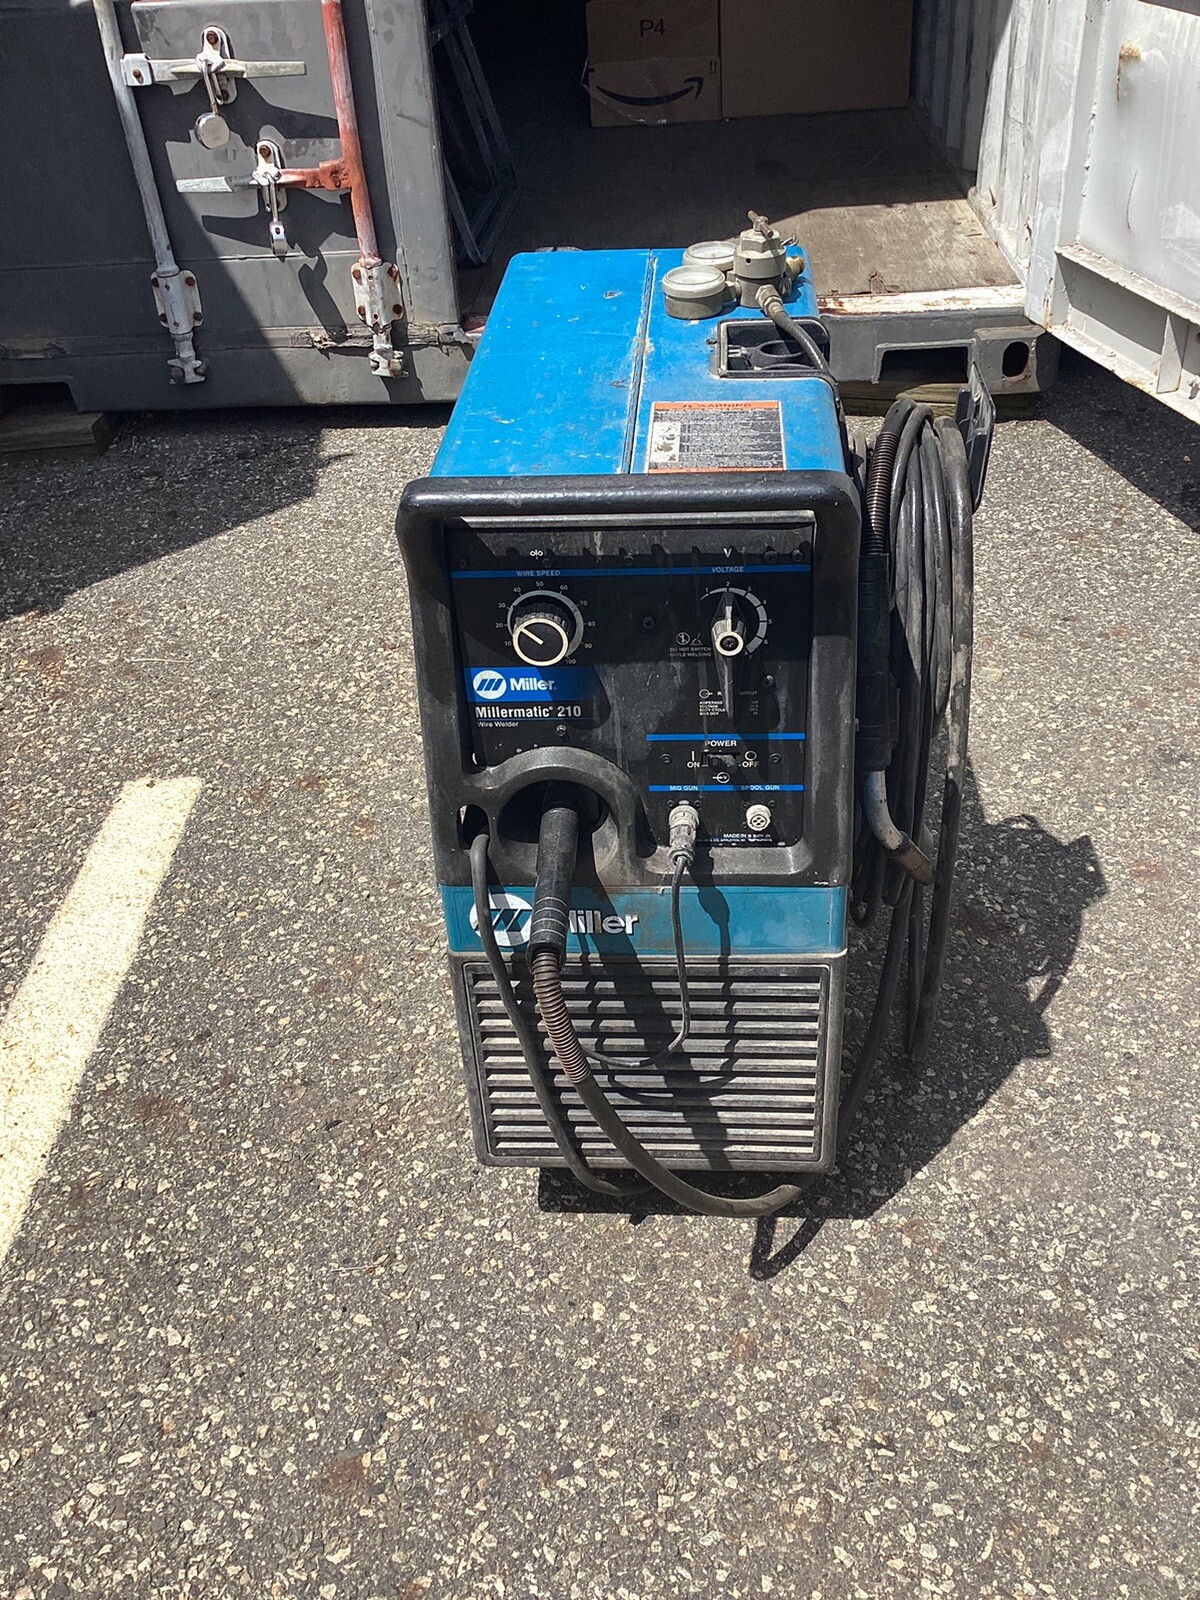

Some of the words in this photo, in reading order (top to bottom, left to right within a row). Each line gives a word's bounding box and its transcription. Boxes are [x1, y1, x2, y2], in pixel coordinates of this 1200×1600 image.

[640, 18, 666, 37] P4
[723, 548, 732, 558] V
[557, 705, 582, 717] 210
[568, 910, 639, 935] iller
